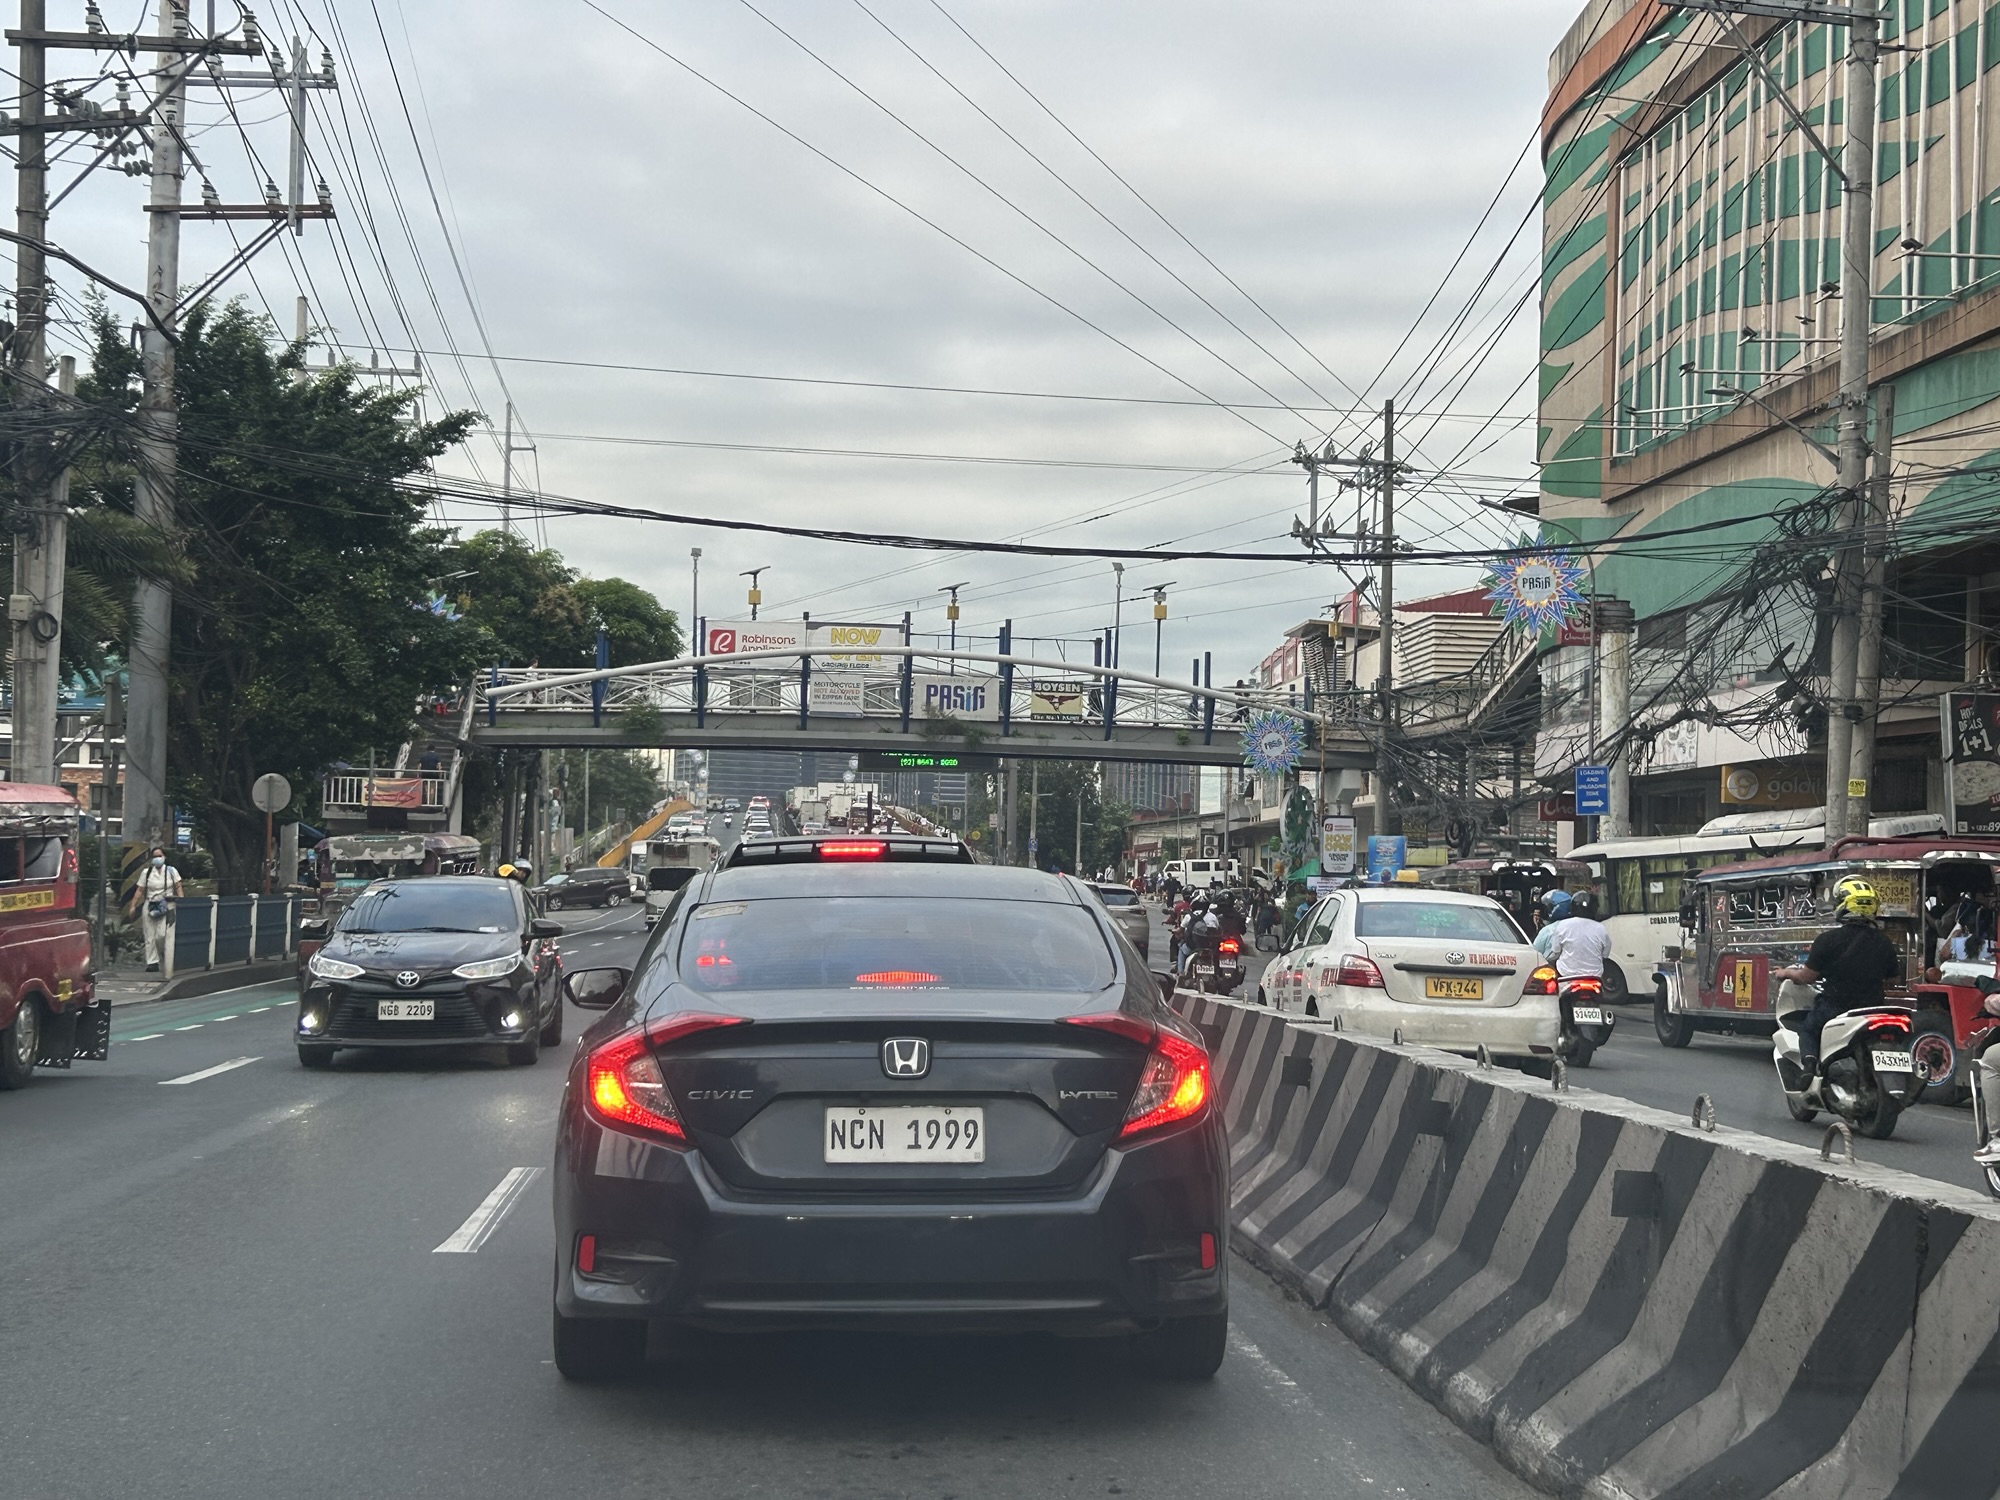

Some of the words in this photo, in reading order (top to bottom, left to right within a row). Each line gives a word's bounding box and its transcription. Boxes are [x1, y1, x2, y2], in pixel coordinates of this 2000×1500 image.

[741, 634, 797, 645] Robinsons
[830, 627, 882, 645] NOW
[813, 681, 862, 689] MOTORCYCLE
[380, 1005, 400, 1016] NGB
[406, 1005, 433, 1016] 2209
[687, 1090, 754, 1100] CIVIC
[831, 1119, 884, 1150] NCN
[906, 1119, 979, 1150] 1999
